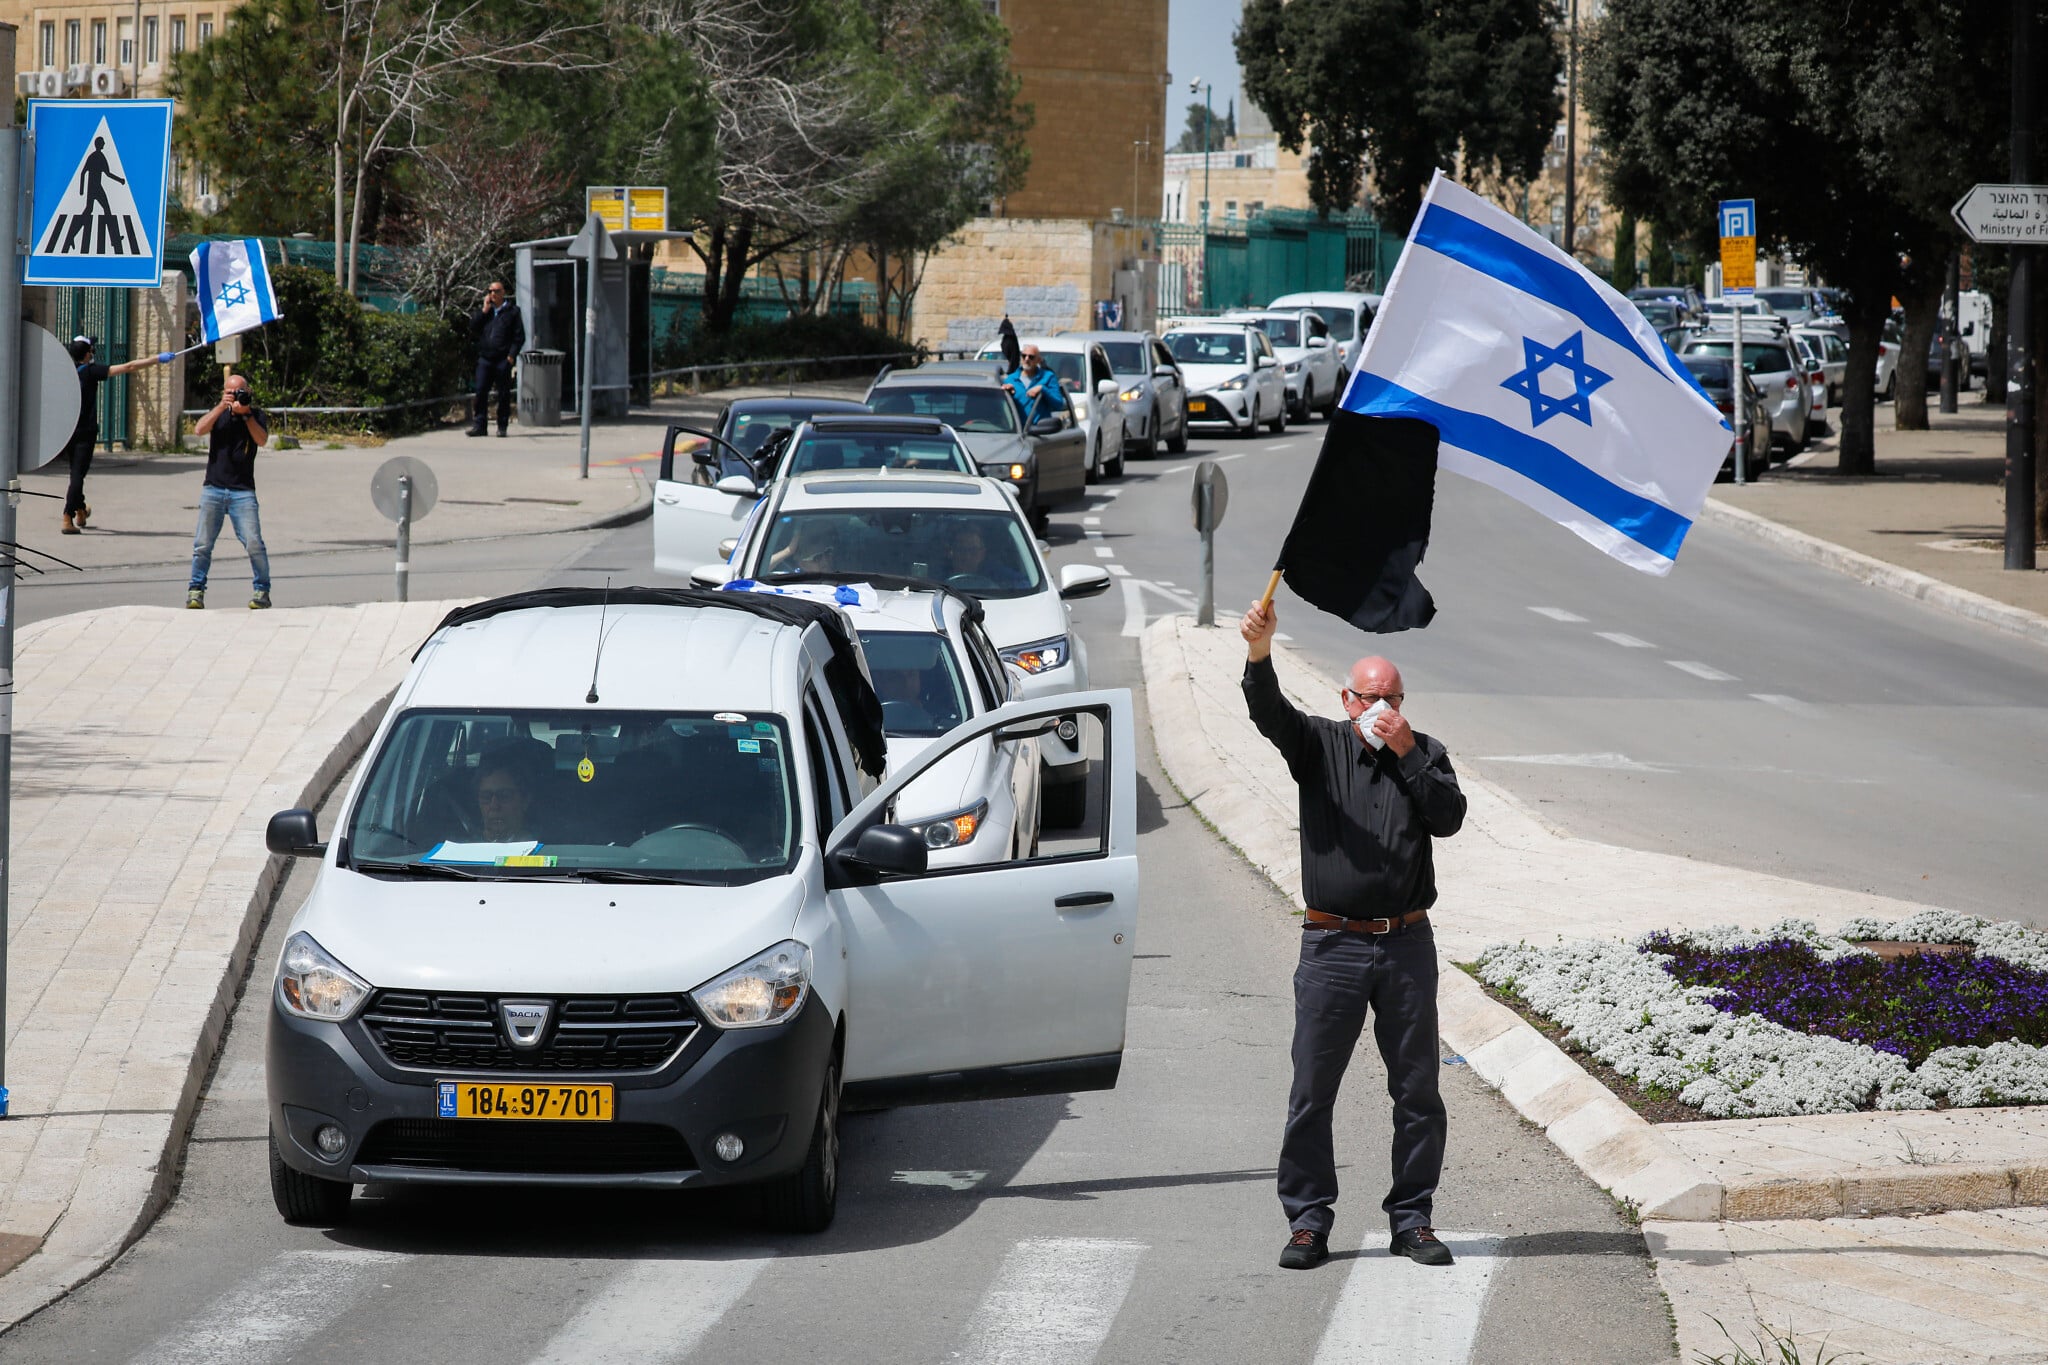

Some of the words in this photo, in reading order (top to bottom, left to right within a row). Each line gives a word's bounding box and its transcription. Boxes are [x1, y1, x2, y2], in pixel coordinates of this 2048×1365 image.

[1989, 193, 2028, 204] האוצר
[1992, 209, 2029, 221] المالية
[1980, 224, 2021, 238] Ministry
[2026, 224, 2036, 235] of
[443, 1093, 454, 1107] IL
